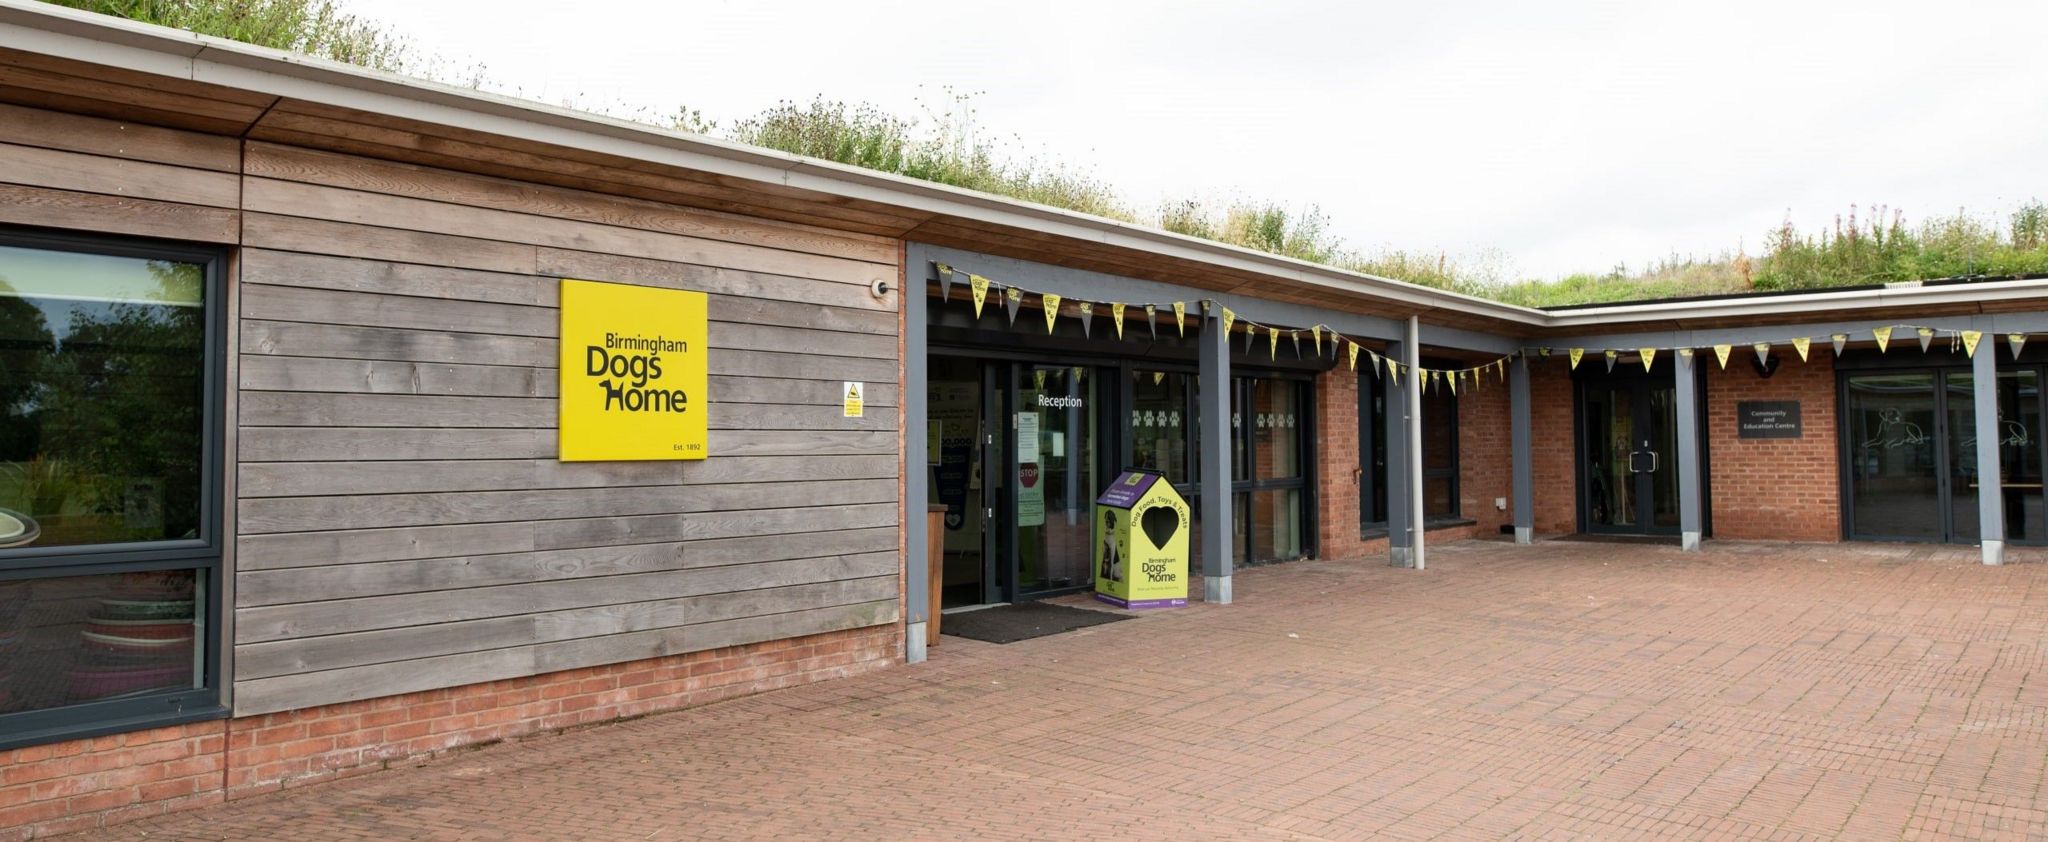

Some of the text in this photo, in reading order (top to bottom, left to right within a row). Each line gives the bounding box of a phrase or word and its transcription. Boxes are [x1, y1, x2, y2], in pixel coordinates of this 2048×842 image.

[606, 333, 687, 355] Birmingham
[587, 345, 662, 388] Dogs
[599, 379, 687, 413] Home
[1038, 394, 1082, 410] Reception
[1020, 469, 1038, 477] STOP
[1131, 511, 1141, 527] Dog
[1158, 496, 1172, 505] Toys
[1177, 505, 1188, 529] Treats
[1142, 562, 1166, 575] Dogs
[1146, 572, 1176, 582] Home
